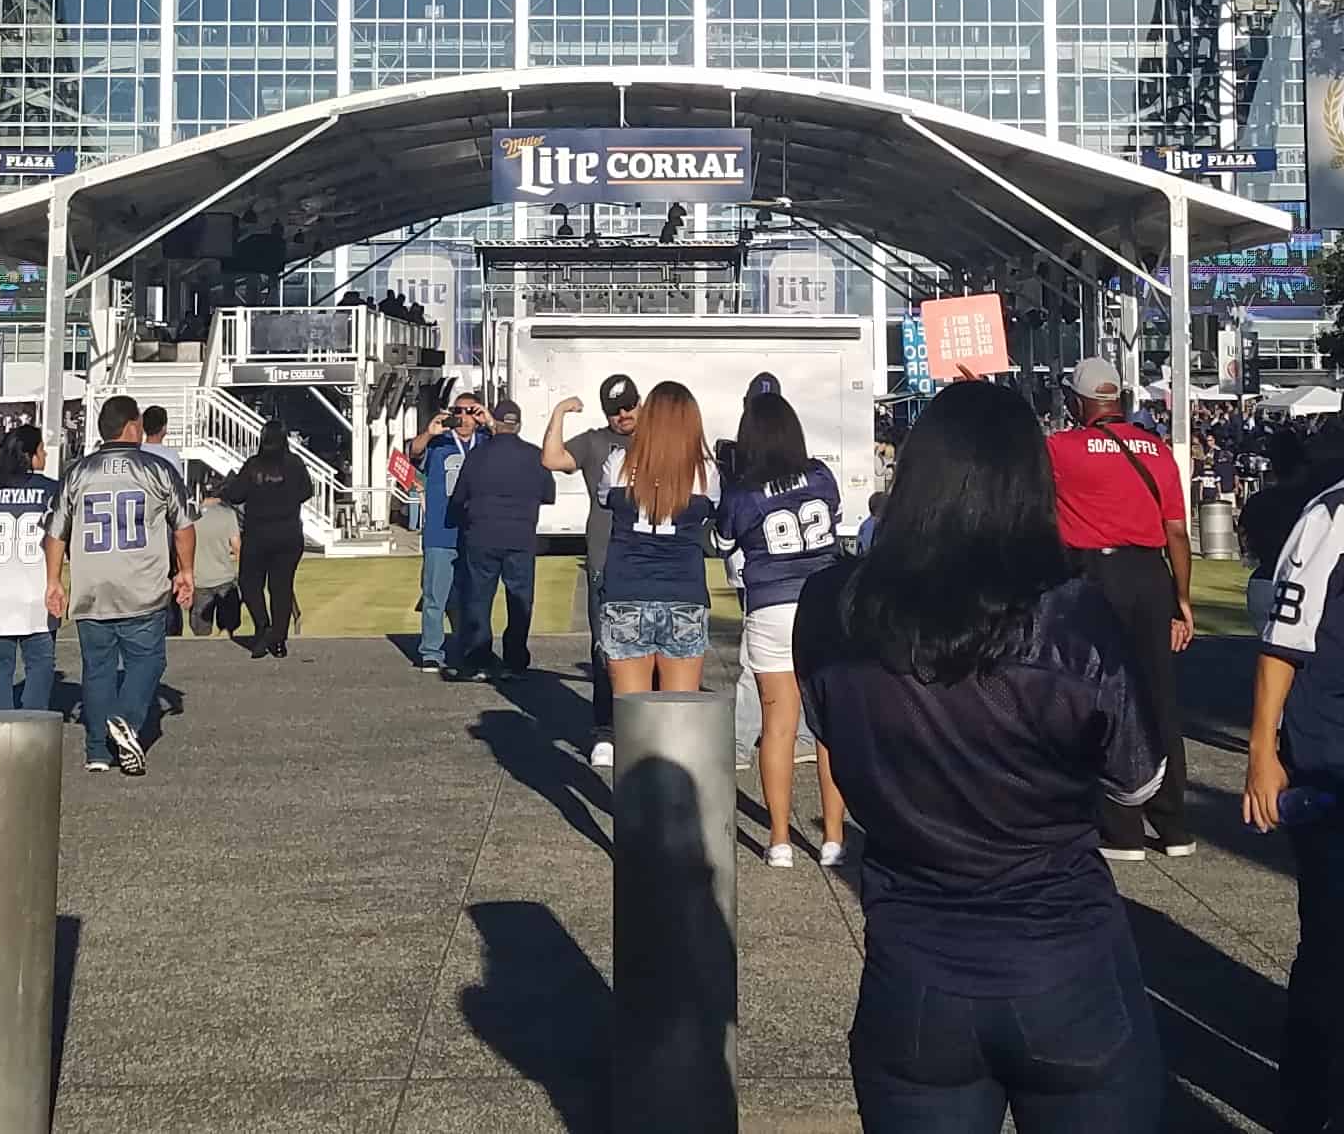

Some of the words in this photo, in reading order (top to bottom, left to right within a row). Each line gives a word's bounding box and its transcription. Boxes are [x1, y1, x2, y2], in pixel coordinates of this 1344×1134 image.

[500, 134, 546, 160] Miller
[6, 155, 55, 167] PLAZA
[516, 145, 600, 196] Lite
[606, 153, 744, 179] CORRAL
[1164, 150, 1203, 174] Lite
[1207, 154, 1256, 166] PLAZA
[1122, 439, 1160, 457] AFFLE
[103, 458, 129, 475] LEE
[83, 490, 148, 554] 50
[763, 499, 834, 554] 82
